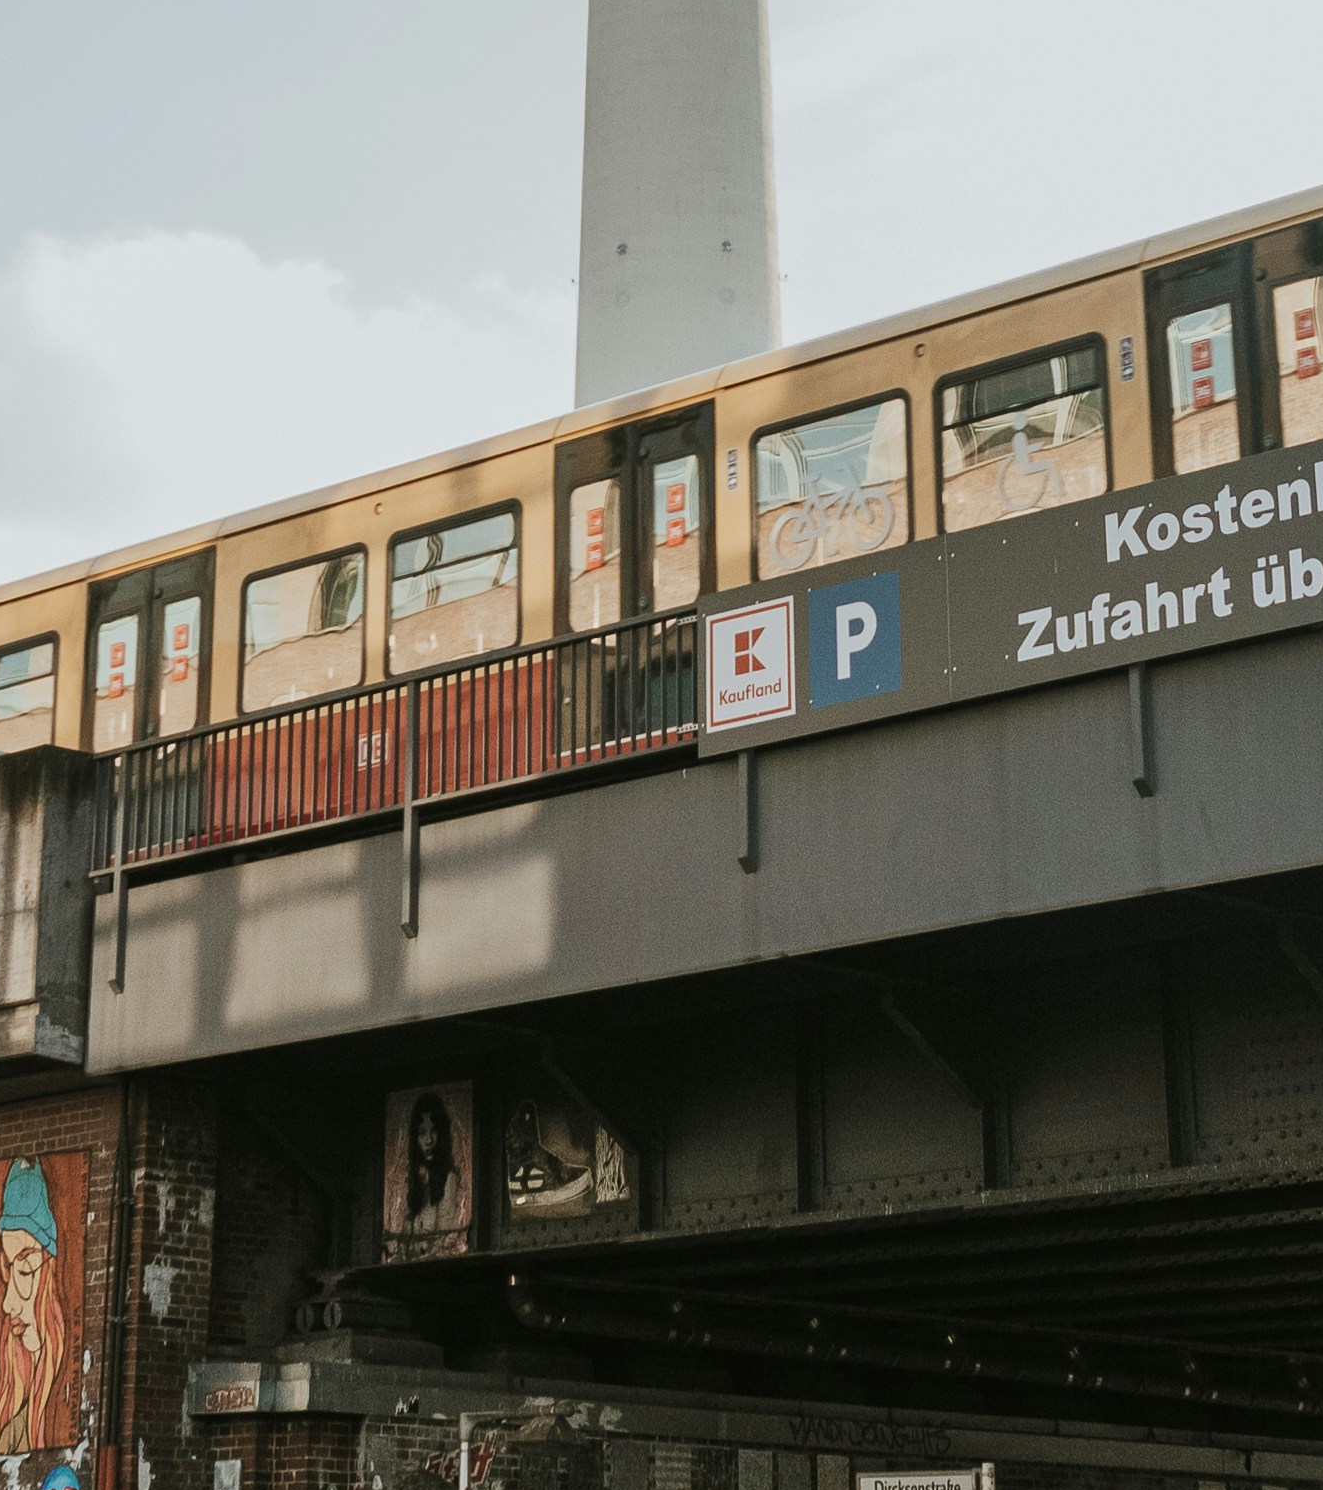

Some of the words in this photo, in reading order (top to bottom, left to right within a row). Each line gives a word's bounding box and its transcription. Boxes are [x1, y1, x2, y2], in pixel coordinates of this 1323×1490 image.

[835, 601, 878, 680] P
[1017, 567, 1234, 663] Zufahrt
[719, 678, 782, 706] Kaufland
